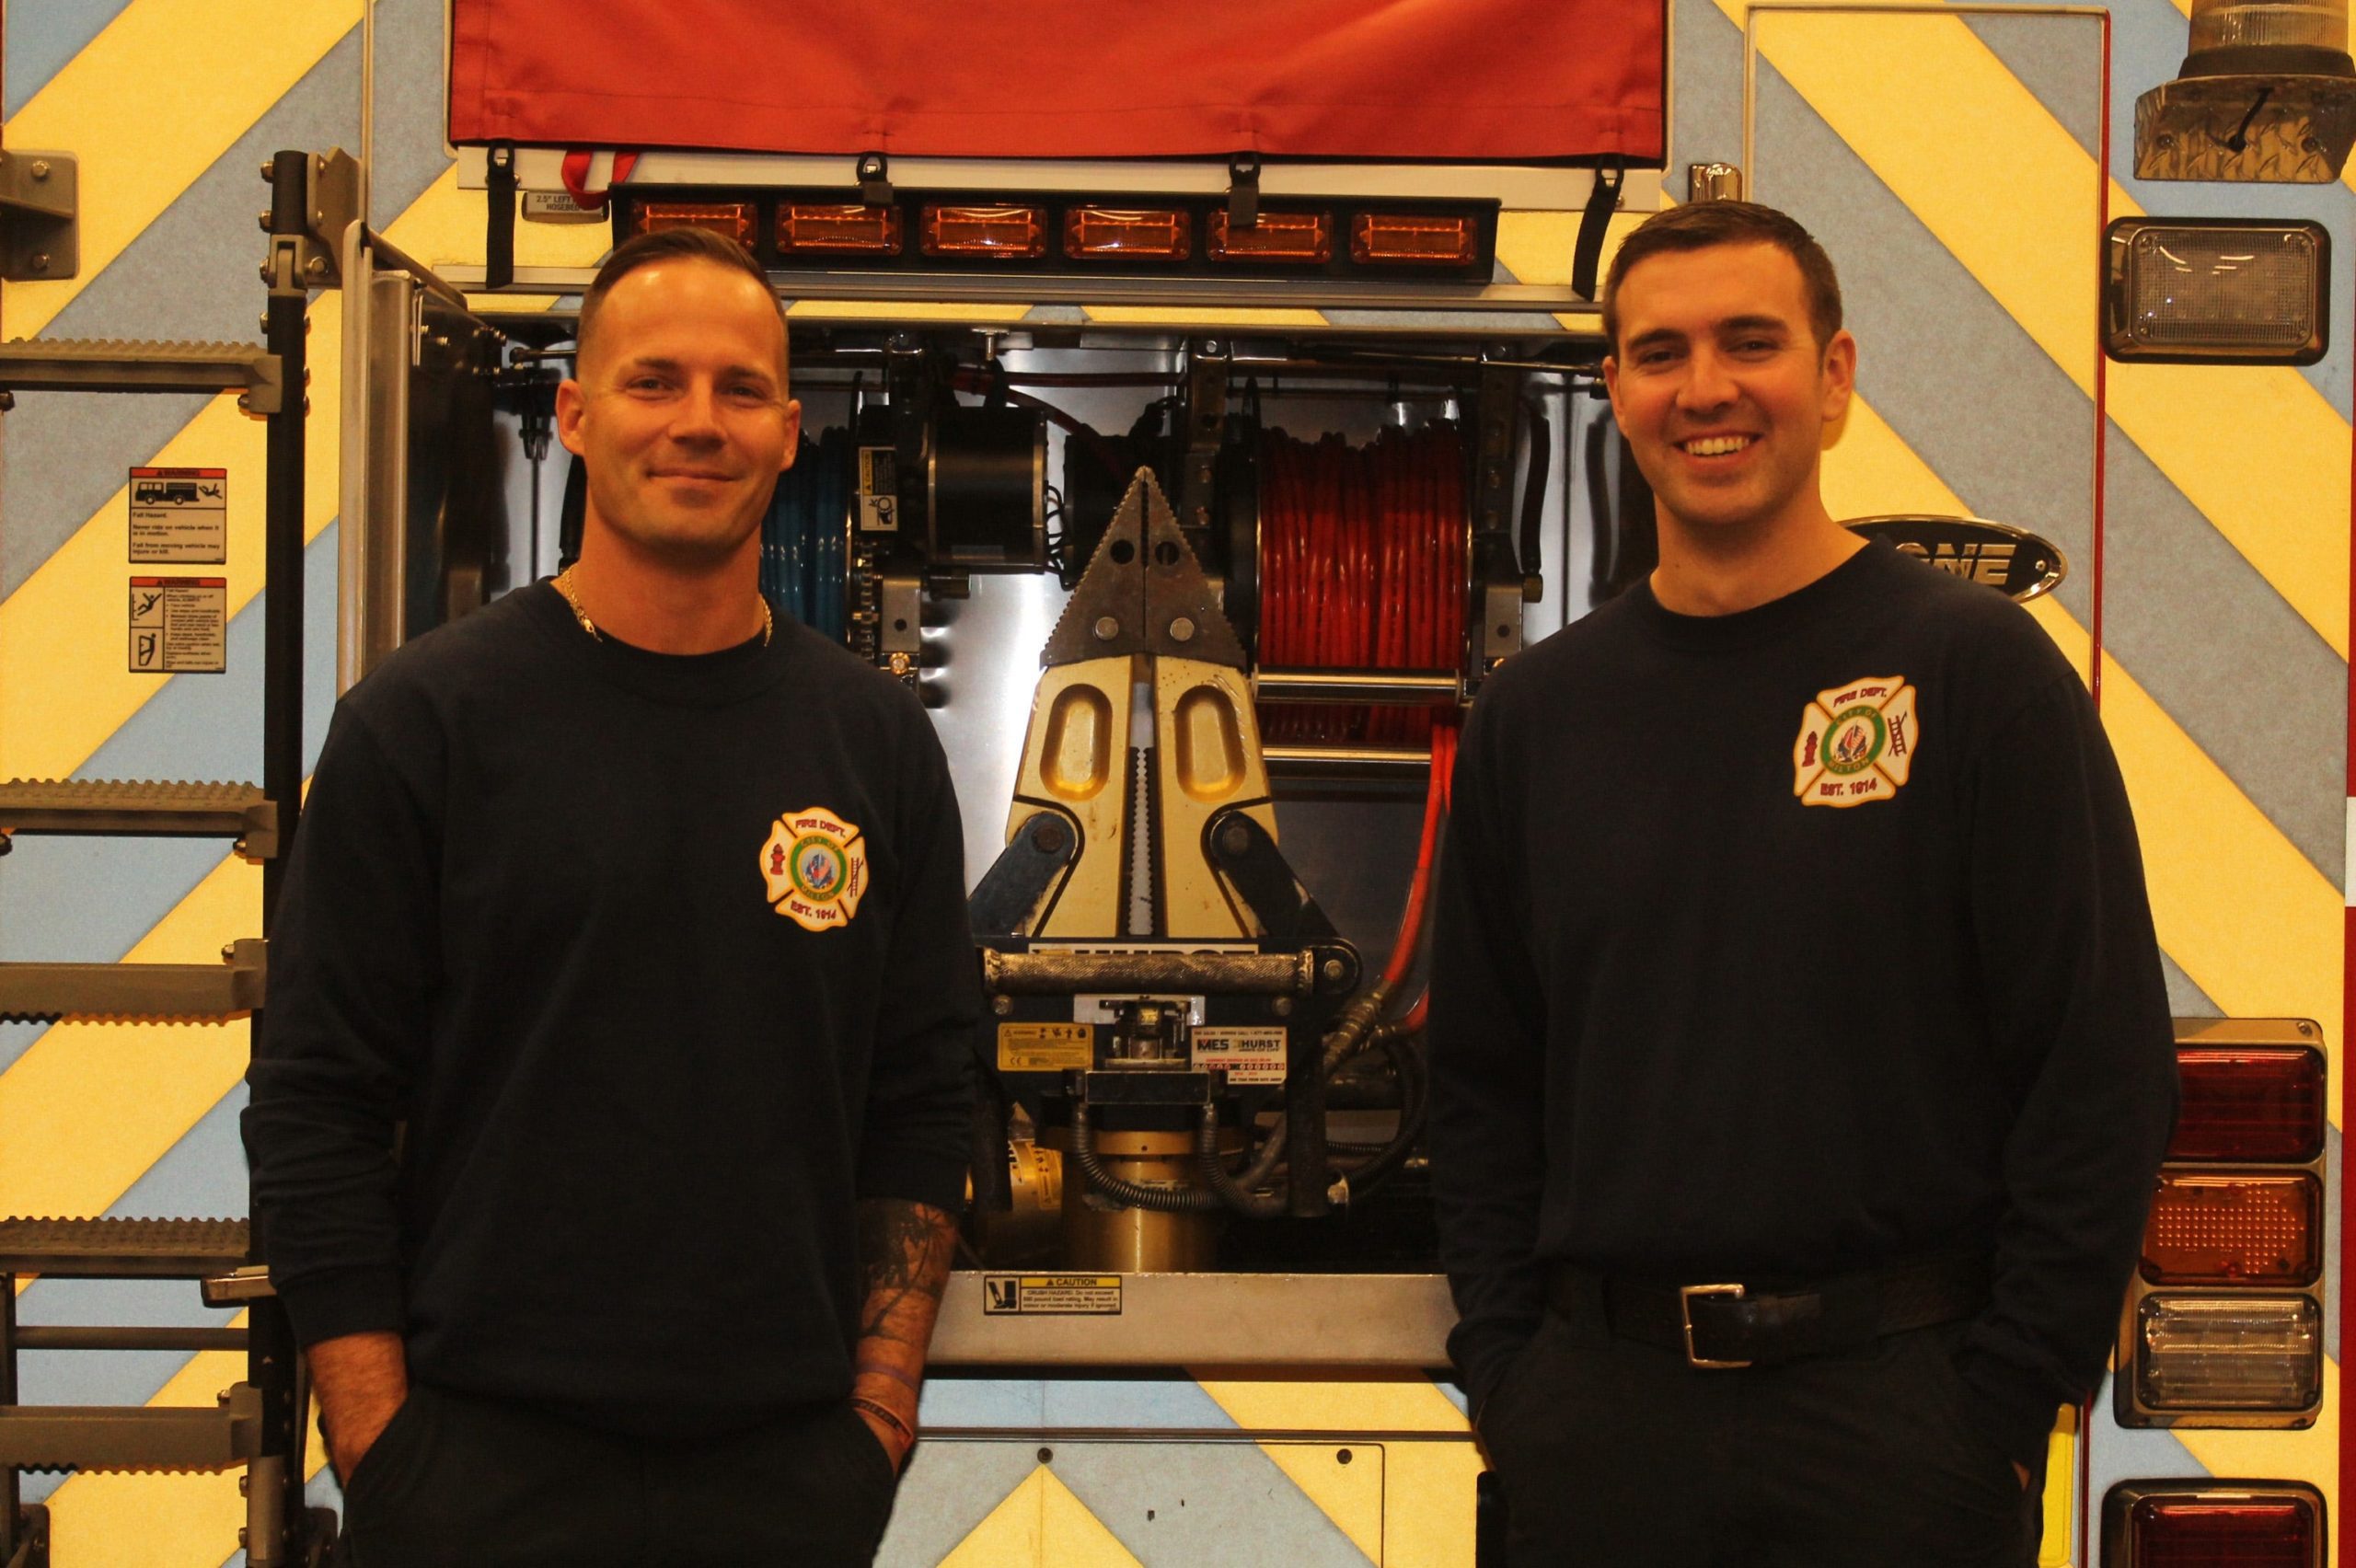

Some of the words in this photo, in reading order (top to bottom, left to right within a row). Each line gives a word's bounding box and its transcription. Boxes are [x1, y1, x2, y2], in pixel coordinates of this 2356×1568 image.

[1833, 690, 1857, 708] FIRE
[1860, 687, 1887, 698] DEPT.
[1820, 783, 1844, 796] EST.
[1850, 778, 1877, 795] 1914
[795, 819, 817, 829] FIRE
[819, 820, 846, 838] DEPT.
[791, 900, 812, 917] EST.
[815, 908, 837, 920] 1914
[1197, 1039, 1230, 1051] MES
[1242, 1040, 1281, 1048] HURST
[1057, 1278, 1097, 1286] CAUTION
